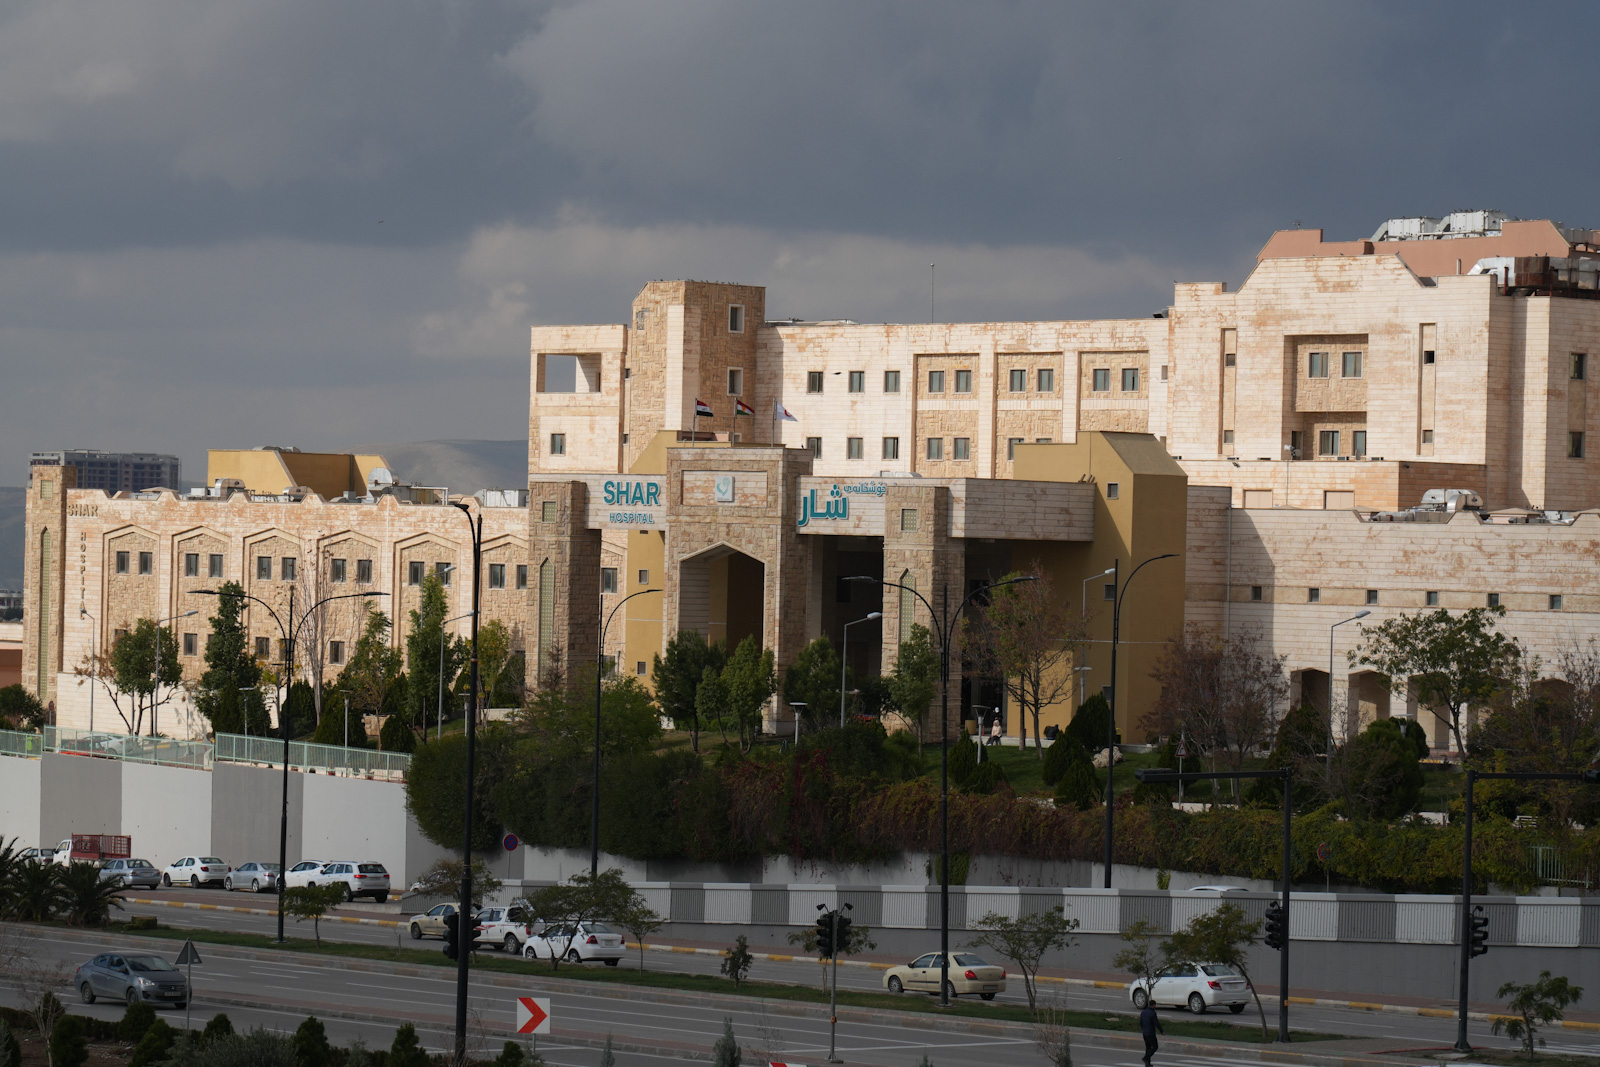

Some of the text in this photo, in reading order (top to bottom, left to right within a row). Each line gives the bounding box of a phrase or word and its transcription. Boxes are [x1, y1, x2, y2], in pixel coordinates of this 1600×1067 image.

[603, 481, 660, 505] SHAR
[843, 481, 896, 496] خۆشخانەی
[67, 503, 99, 517] SHAR
[797, 484, 848, 526] شار
[609, 512, 655, 524] HOSPITAL
